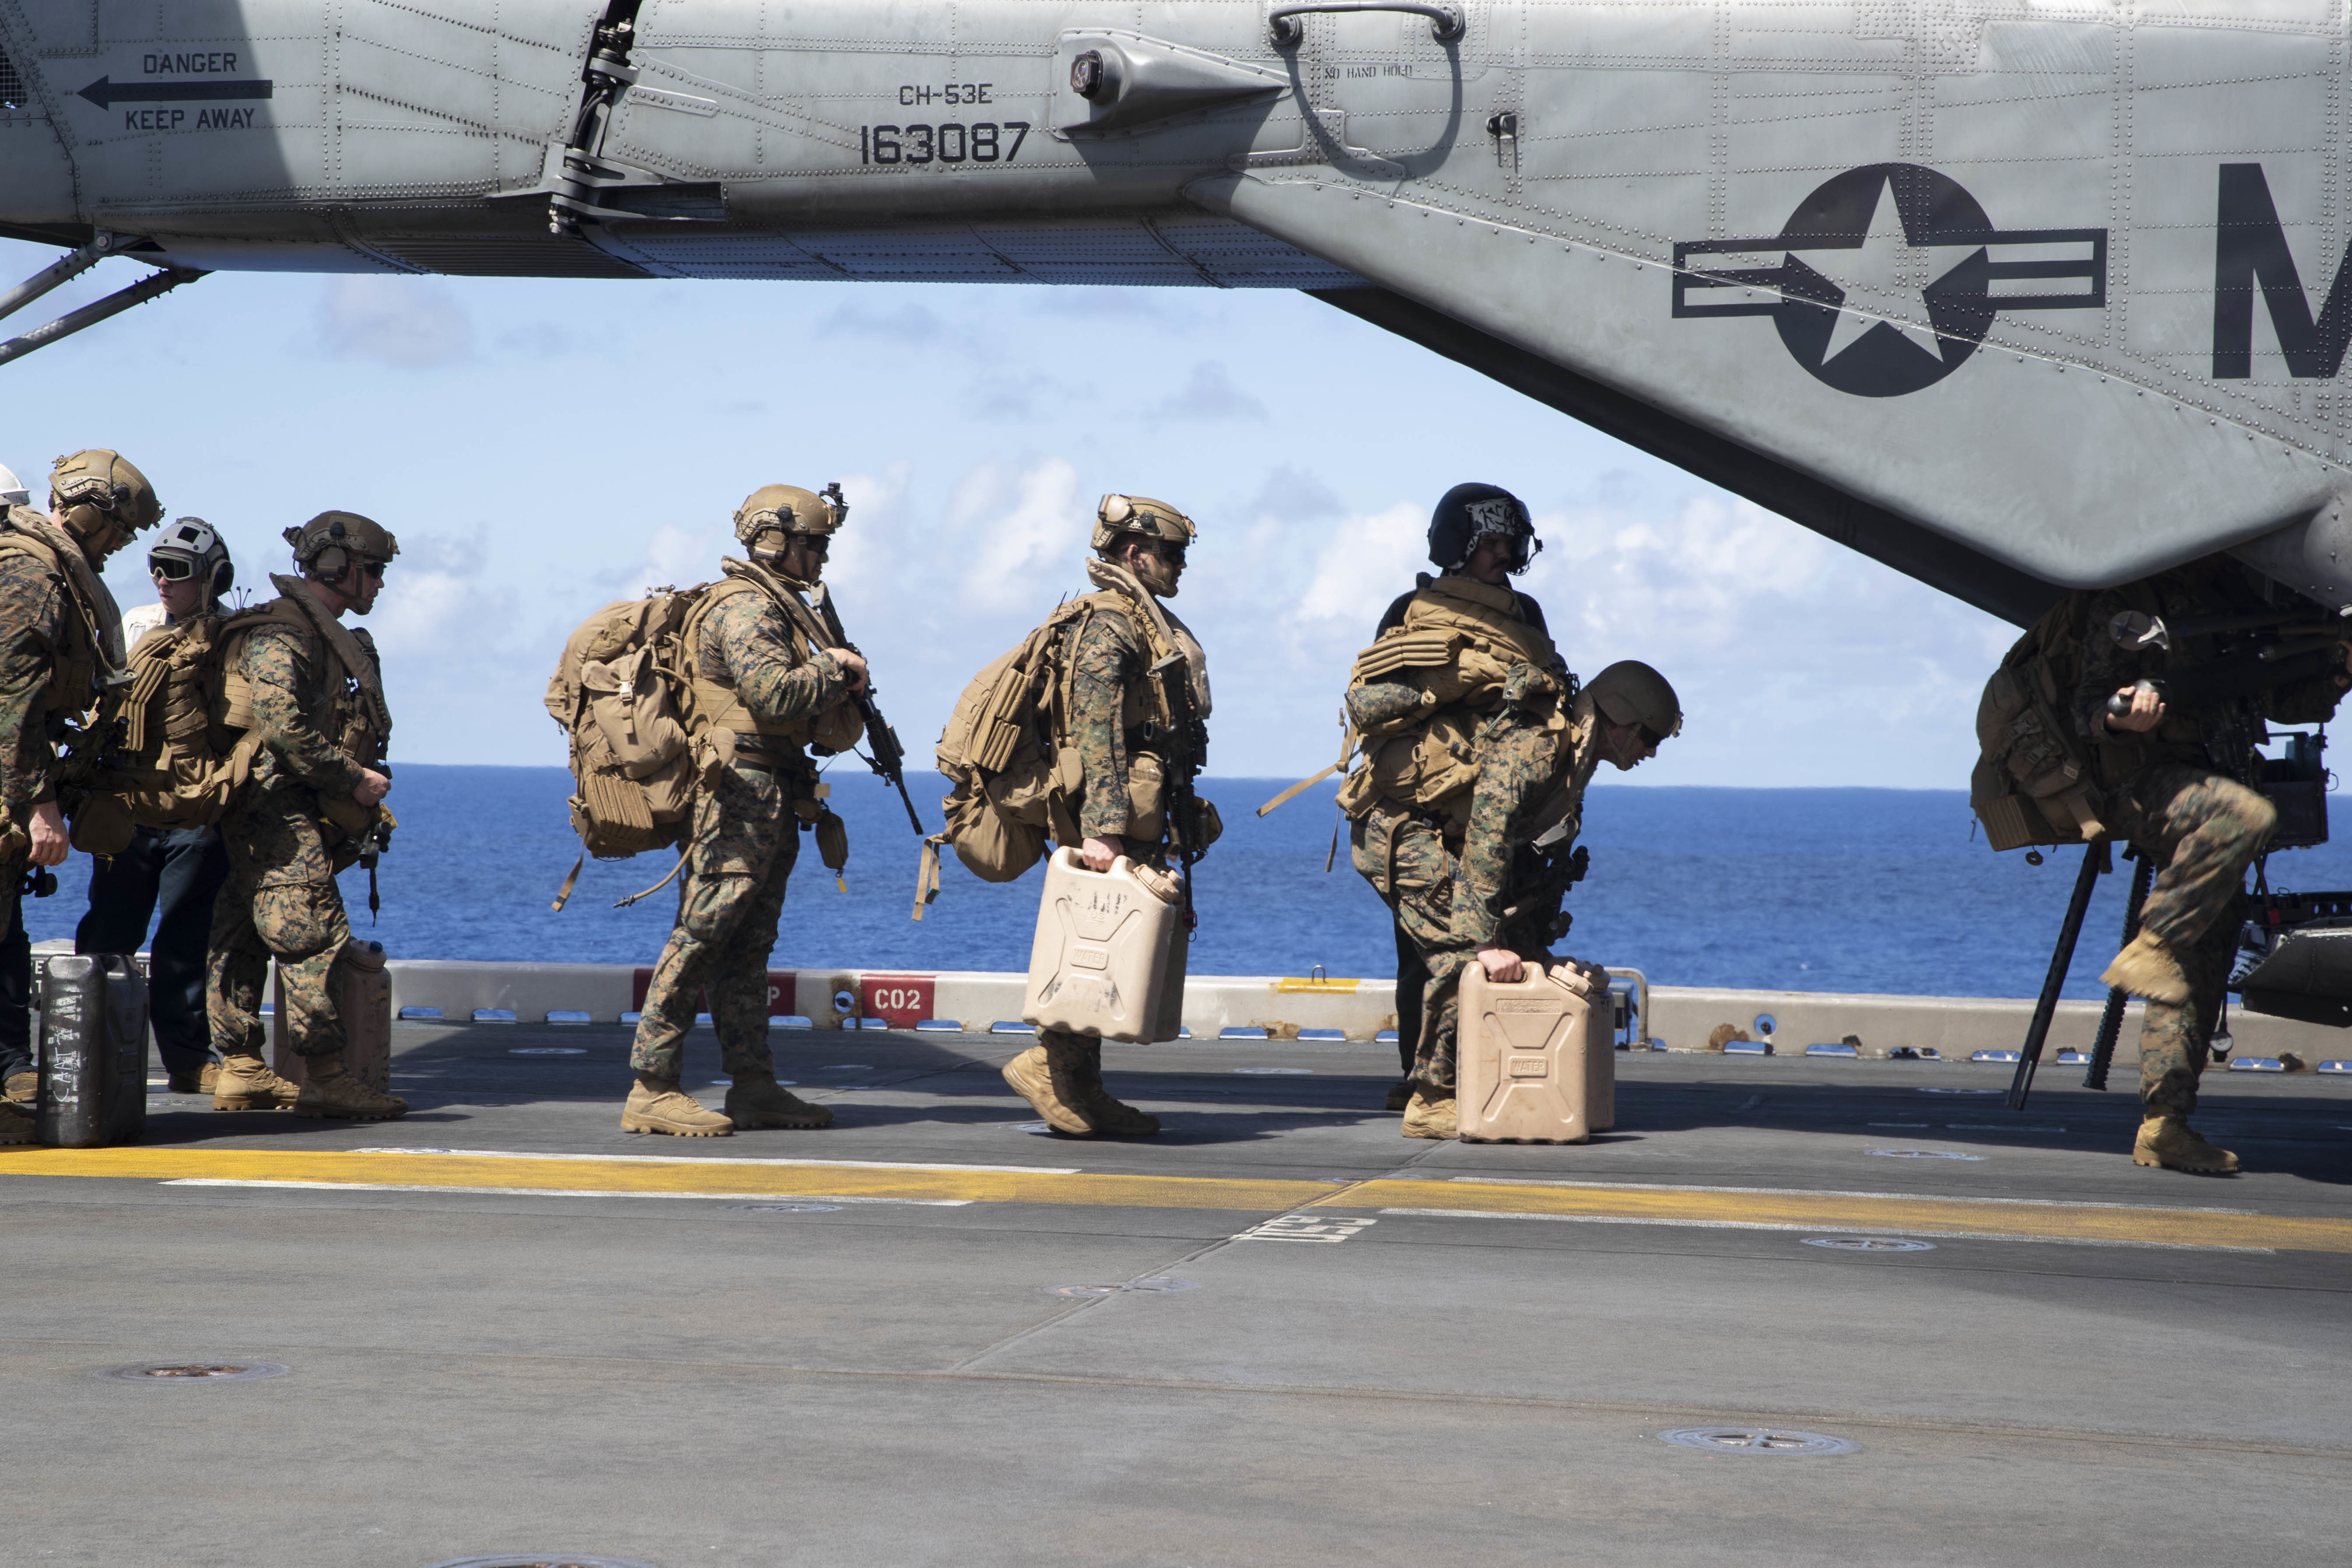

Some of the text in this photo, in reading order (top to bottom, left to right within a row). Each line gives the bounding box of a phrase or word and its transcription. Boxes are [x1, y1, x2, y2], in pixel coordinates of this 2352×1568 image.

[144, 53, 236, 74] DANGER
[1325, 65, 1412, 80] NO HAND HOLD
[900, 83, 993, 105] CH-53E
[126, 108, 255, 130] KEEP AWAY
[861, 122, 1031, 165] 163087
[1074, 948, 1105, 965] WATER
[875, 989, 921, 1009] CO2
[1512, 1060, 1544, 1073] WATER
